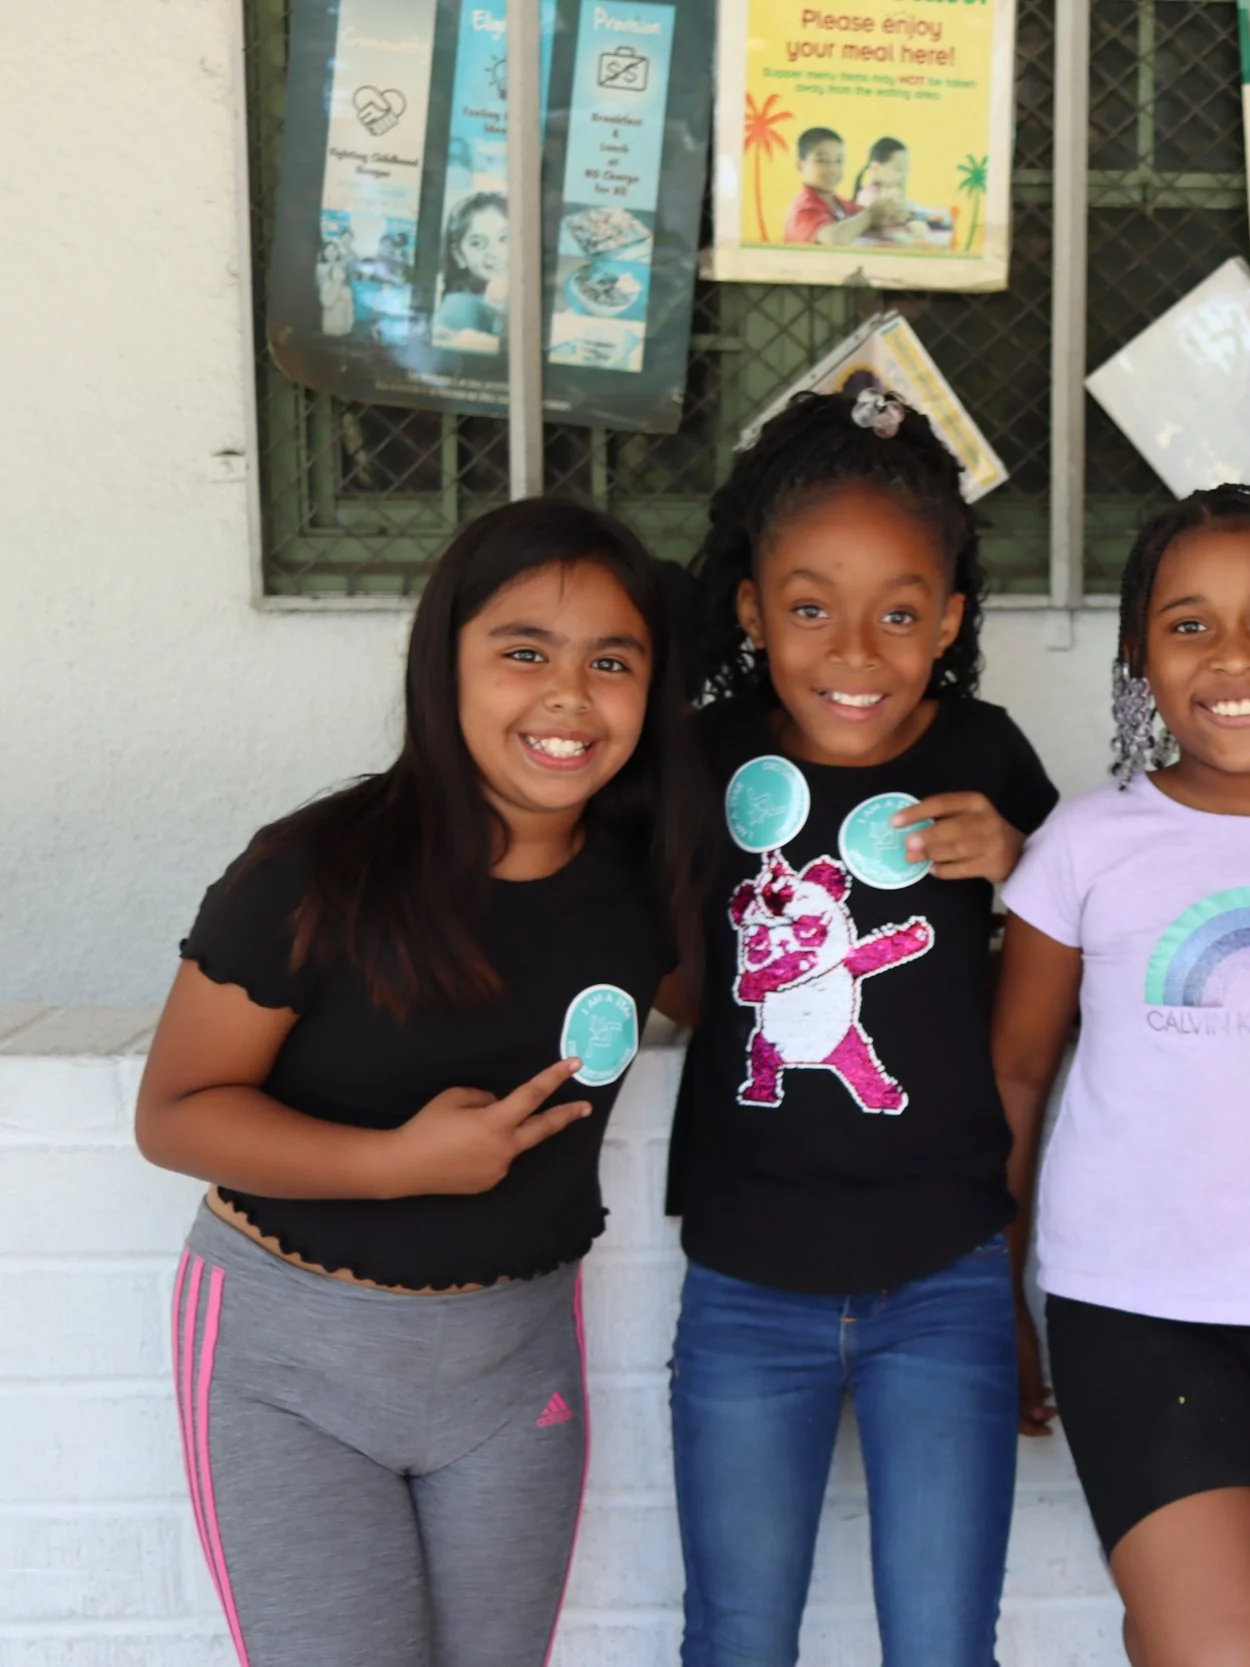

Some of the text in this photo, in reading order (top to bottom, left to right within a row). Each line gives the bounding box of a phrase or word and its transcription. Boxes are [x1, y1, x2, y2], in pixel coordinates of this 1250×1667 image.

[801, 9, 943, 42] Please enjoy
[786, 41, 955, 66] your meal here!
[899, 75, 924, 86] NOT
[1146, 1010, 1229, 1035] CALVIN
